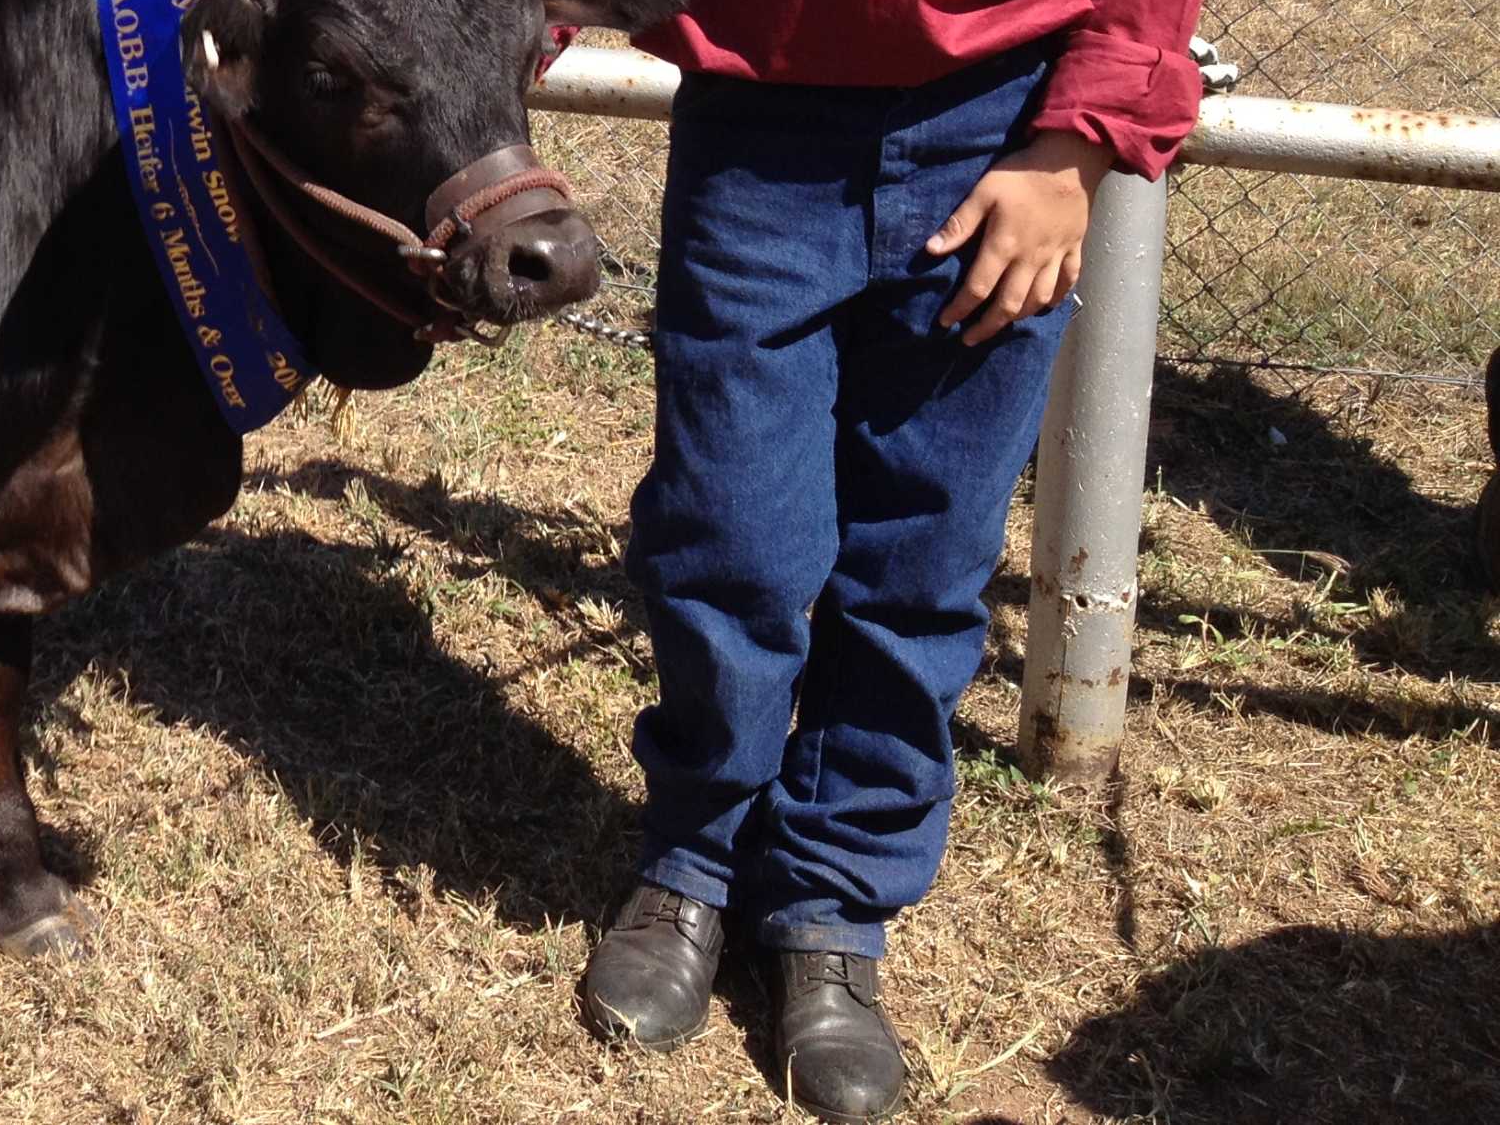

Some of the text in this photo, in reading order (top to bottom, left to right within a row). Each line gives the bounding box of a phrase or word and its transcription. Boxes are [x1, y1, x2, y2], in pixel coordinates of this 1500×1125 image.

[128, 104, 163, 193] Heifer
[151, 202, 176, 221] 6
[160, 226, 207, 320] Months
[197, 325, 222, 349] &
[211, 354, 247, 409] Over
